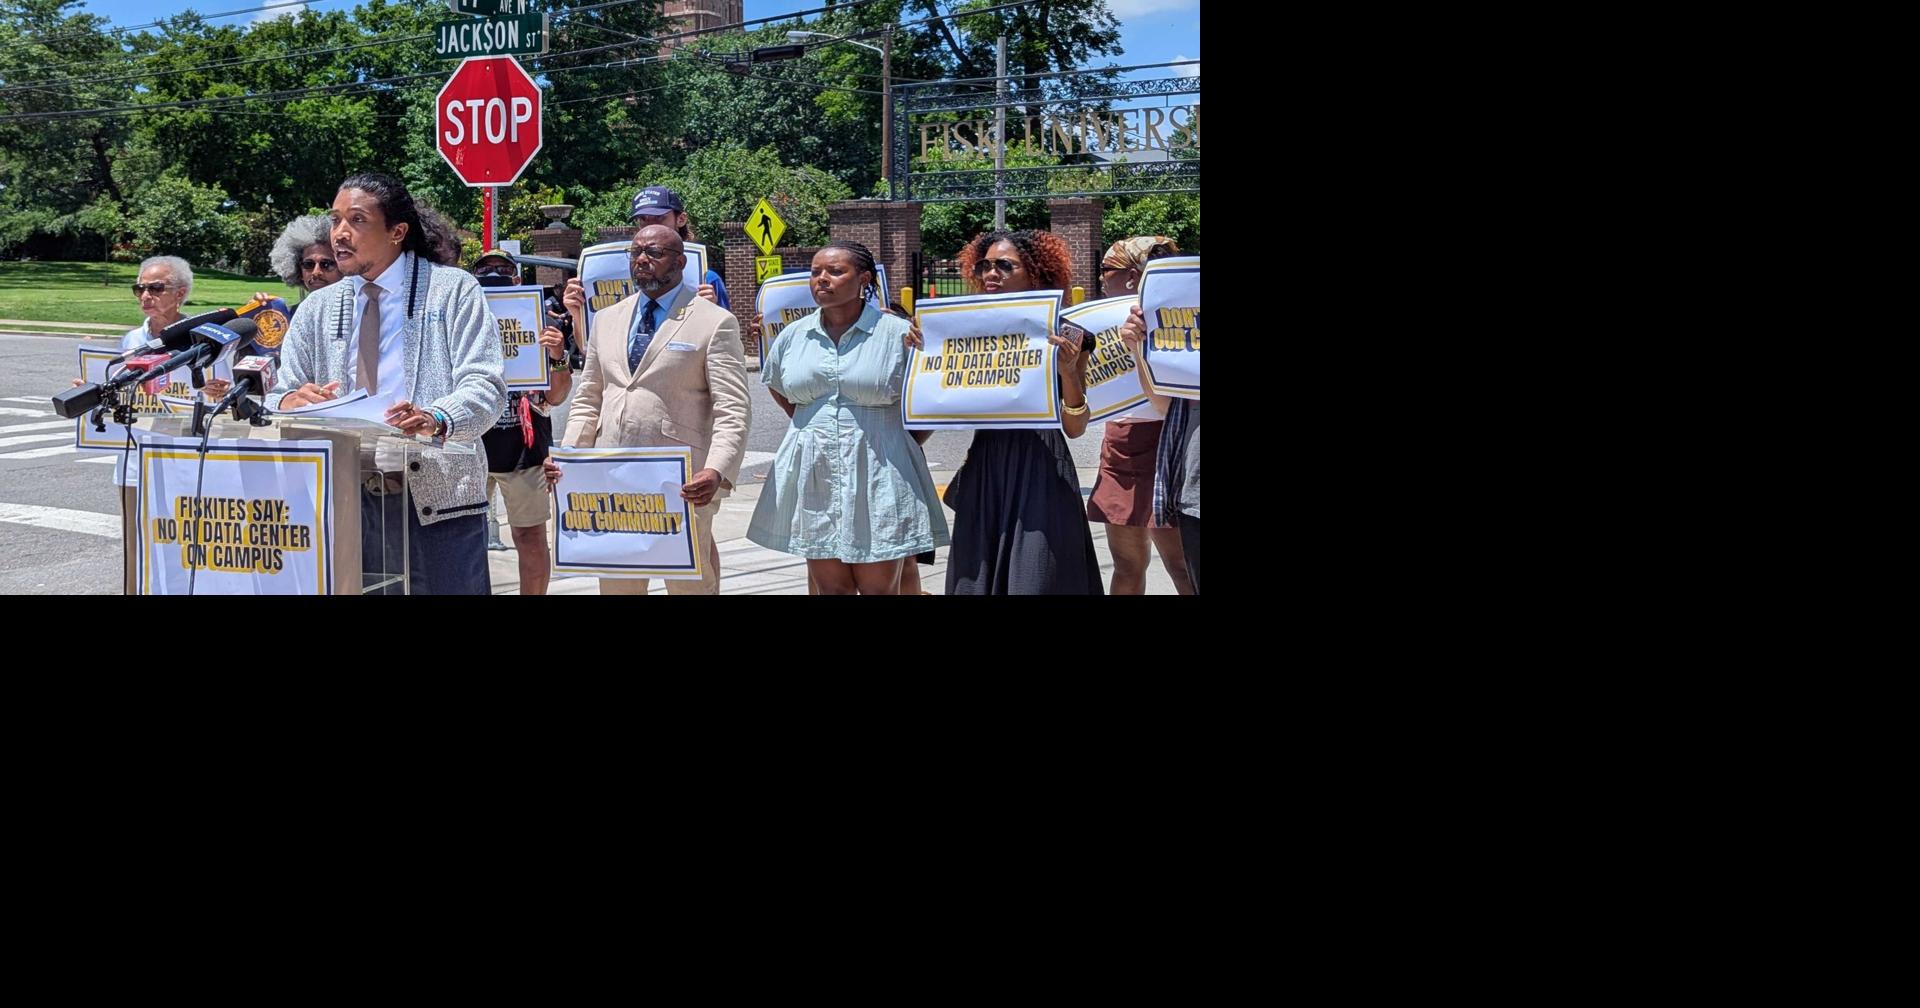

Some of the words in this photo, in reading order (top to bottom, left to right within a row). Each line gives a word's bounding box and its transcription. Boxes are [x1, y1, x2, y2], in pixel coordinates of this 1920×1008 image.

[436, 20, 519, 54] JACKSON
[526, 32, 536, 48] ST
[445, 96, 532, 146] STOP
[919, 119, 998, 162] FISK
[498, 318, 522, 330] SAY:
[500, 331, 536, 344] ENTER
[946, 336, 998, 354] FISKITES
[1002, 333, 1030, 350] SAY:
[1150, 328, 1186, 352] OUR
[925, 356, 942, 370] NO
[946, 355, 958, 370] AI
[962, 353, 992, 370] DATA
[998, 349, 1042, 368] CENTER
[1086, 354, 1136, 384] CAMPUS
[946, 371, 963, 386] ON
[967, 368, 1020, 386] CAMPUS
[180, 496, 246, 520] FISKITES
[252, 500, 290, 522] SAY:
[567, 492, 610, 512] DON'T
[610, 492, 666, 514] POISON
[158, 518, 176, 540] NO
[204, 521, 242, 544] DATA
[250, 524, 310, 548] CENTER
[562, 510, 592, 532] OUR
[591, 511, 683, 534] COMMUNITY
[188, 544, 206, 566] ON
[214, 546, 282, 570] CAMPUS
